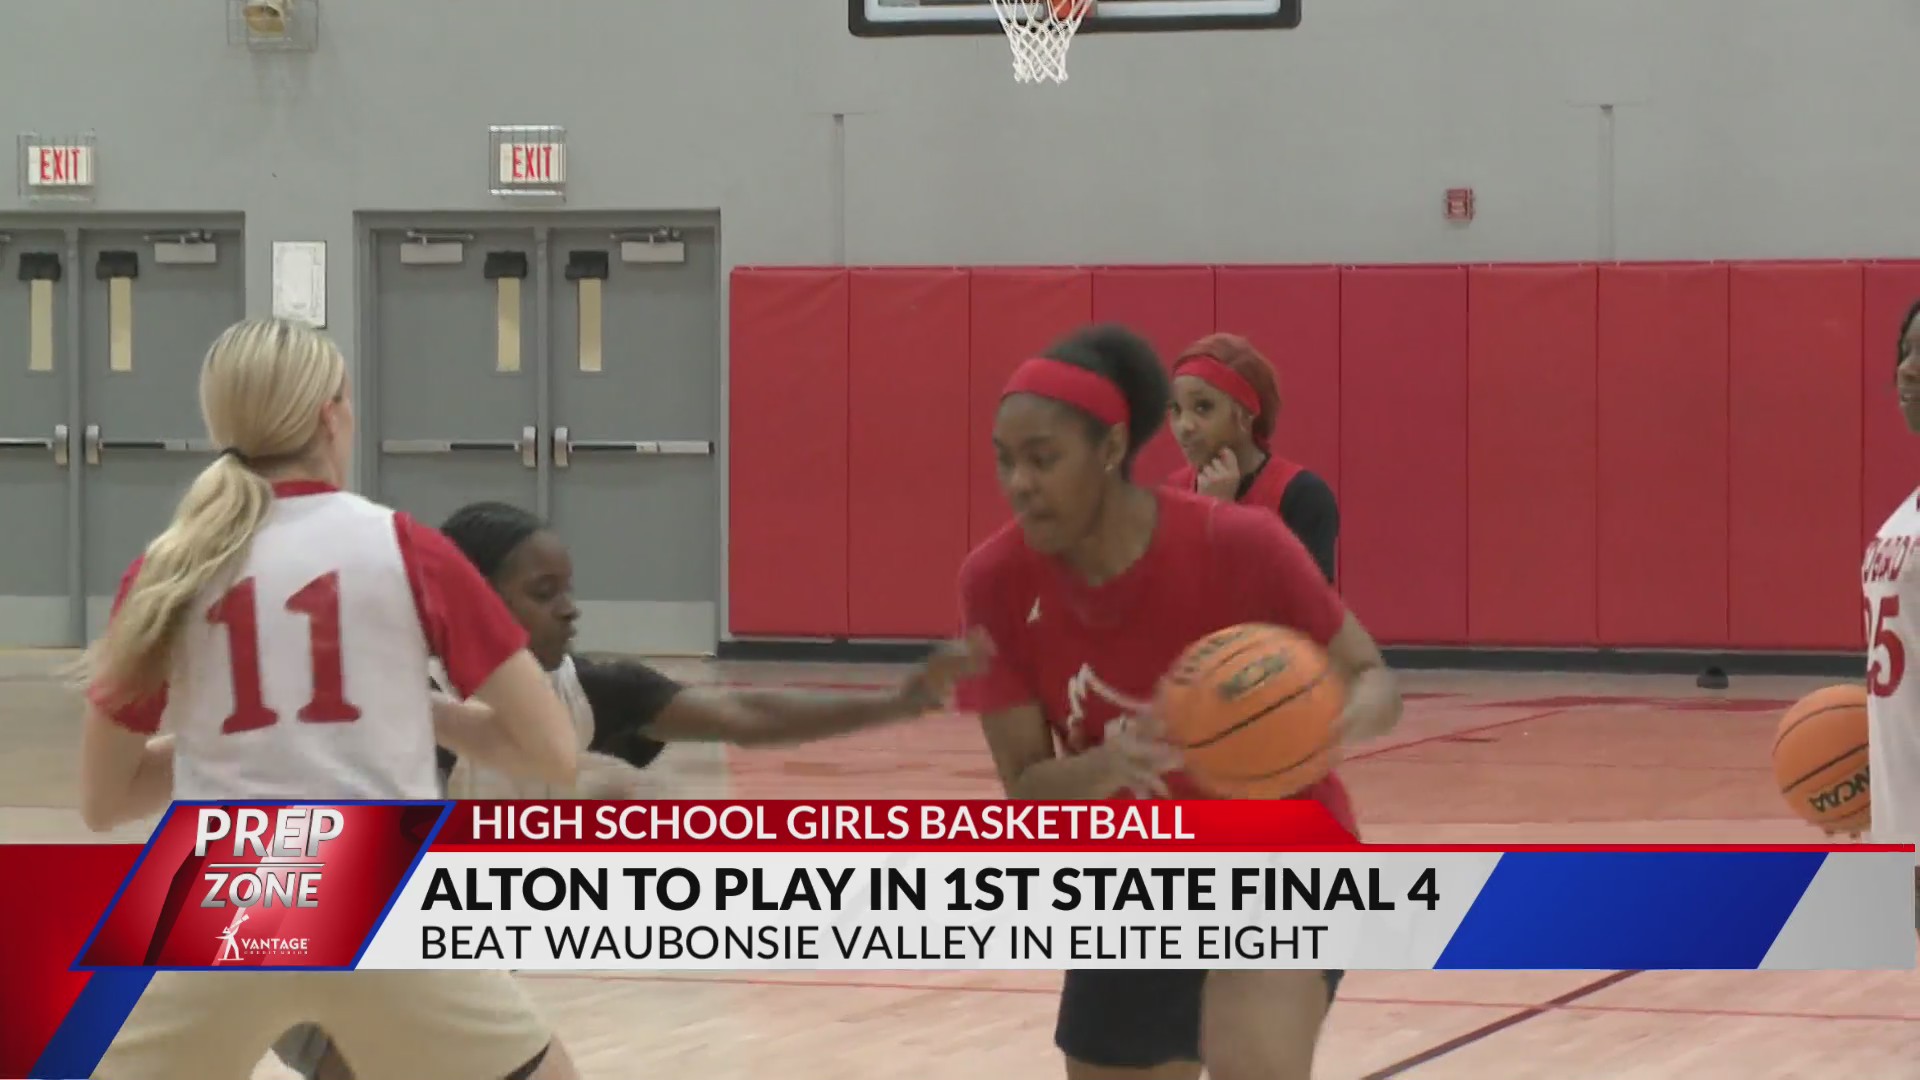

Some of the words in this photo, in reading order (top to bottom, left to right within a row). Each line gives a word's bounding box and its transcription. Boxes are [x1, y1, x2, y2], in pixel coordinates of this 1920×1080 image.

[40, 148, 80, 180] EXIT
[512, 145, 552, 178] EXIT
[206, 569, 361, 735] 11
[1864, 594, 1905, 698] 5
